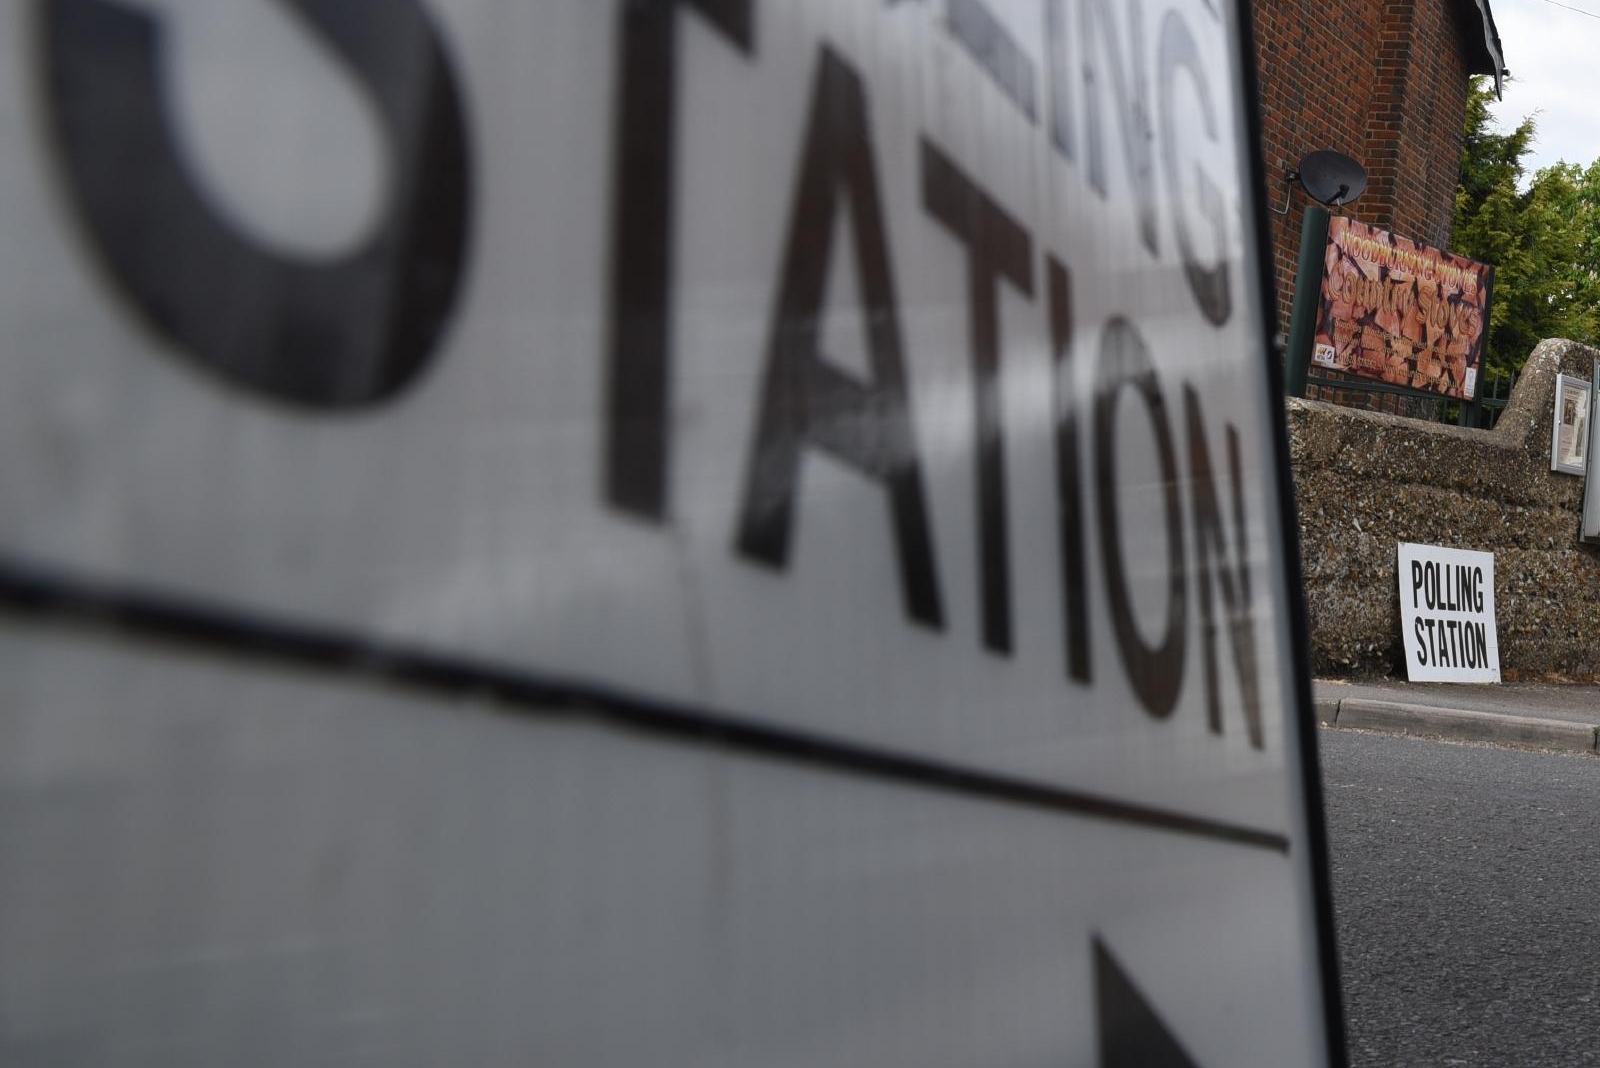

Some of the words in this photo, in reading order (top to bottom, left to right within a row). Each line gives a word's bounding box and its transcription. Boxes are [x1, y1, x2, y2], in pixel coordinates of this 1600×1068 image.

[1415, 285, 1482, 336] Stoves
[1411, 559, 1484, 613] POLLING
[1414, 616, 1489, 669] STATION
